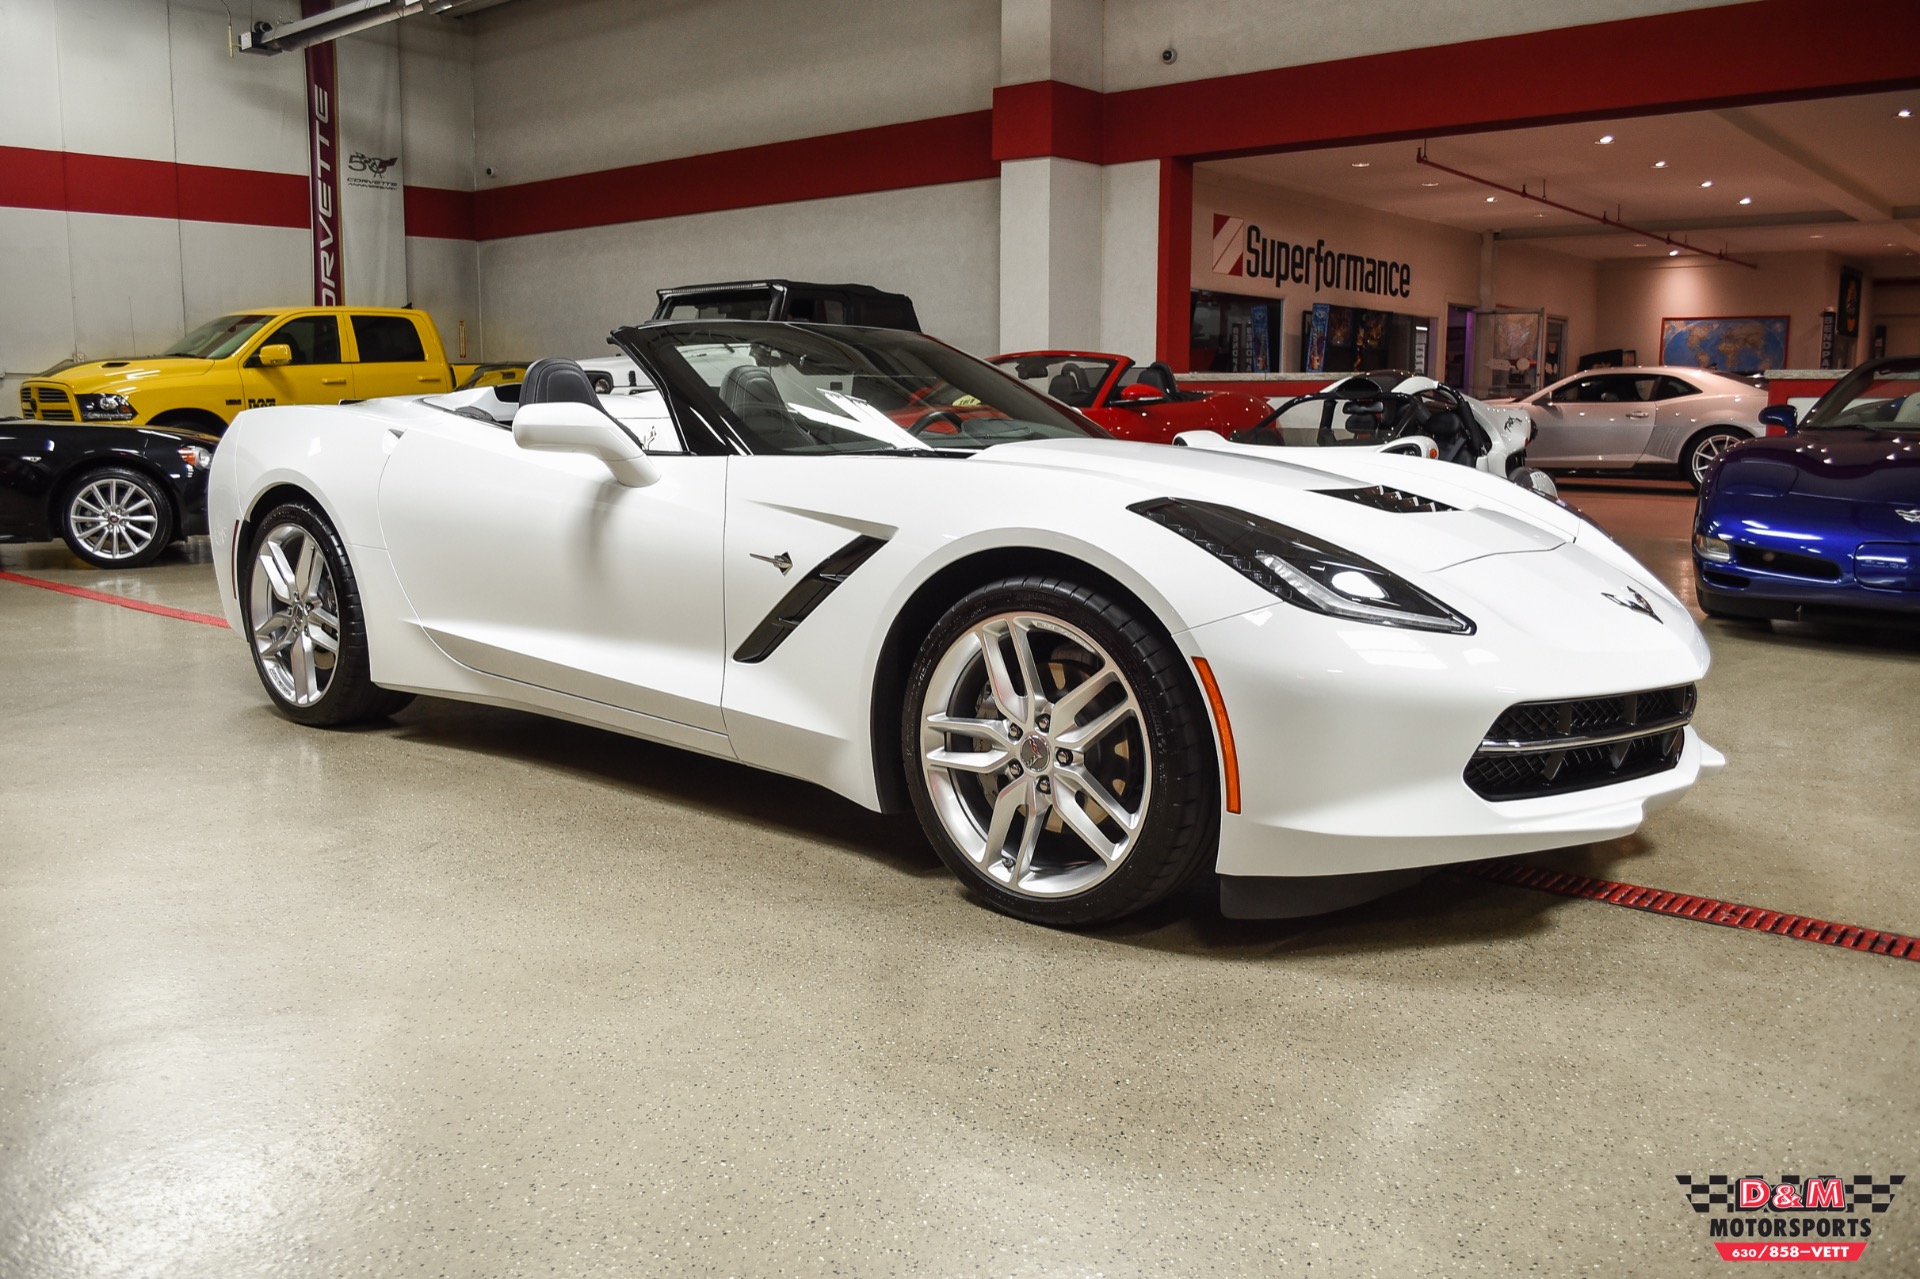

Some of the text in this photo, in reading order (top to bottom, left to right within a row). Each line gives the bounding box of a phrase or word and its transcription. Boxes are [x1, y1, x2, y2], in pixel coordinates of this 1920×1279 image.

[315, 84, 336, 306] ORVETTE
[347, 178, 397, 187] CORVETTE
[1246, 224, 1410, 298] Superformance
[1822, 316, 1833, 369] BENDPA
